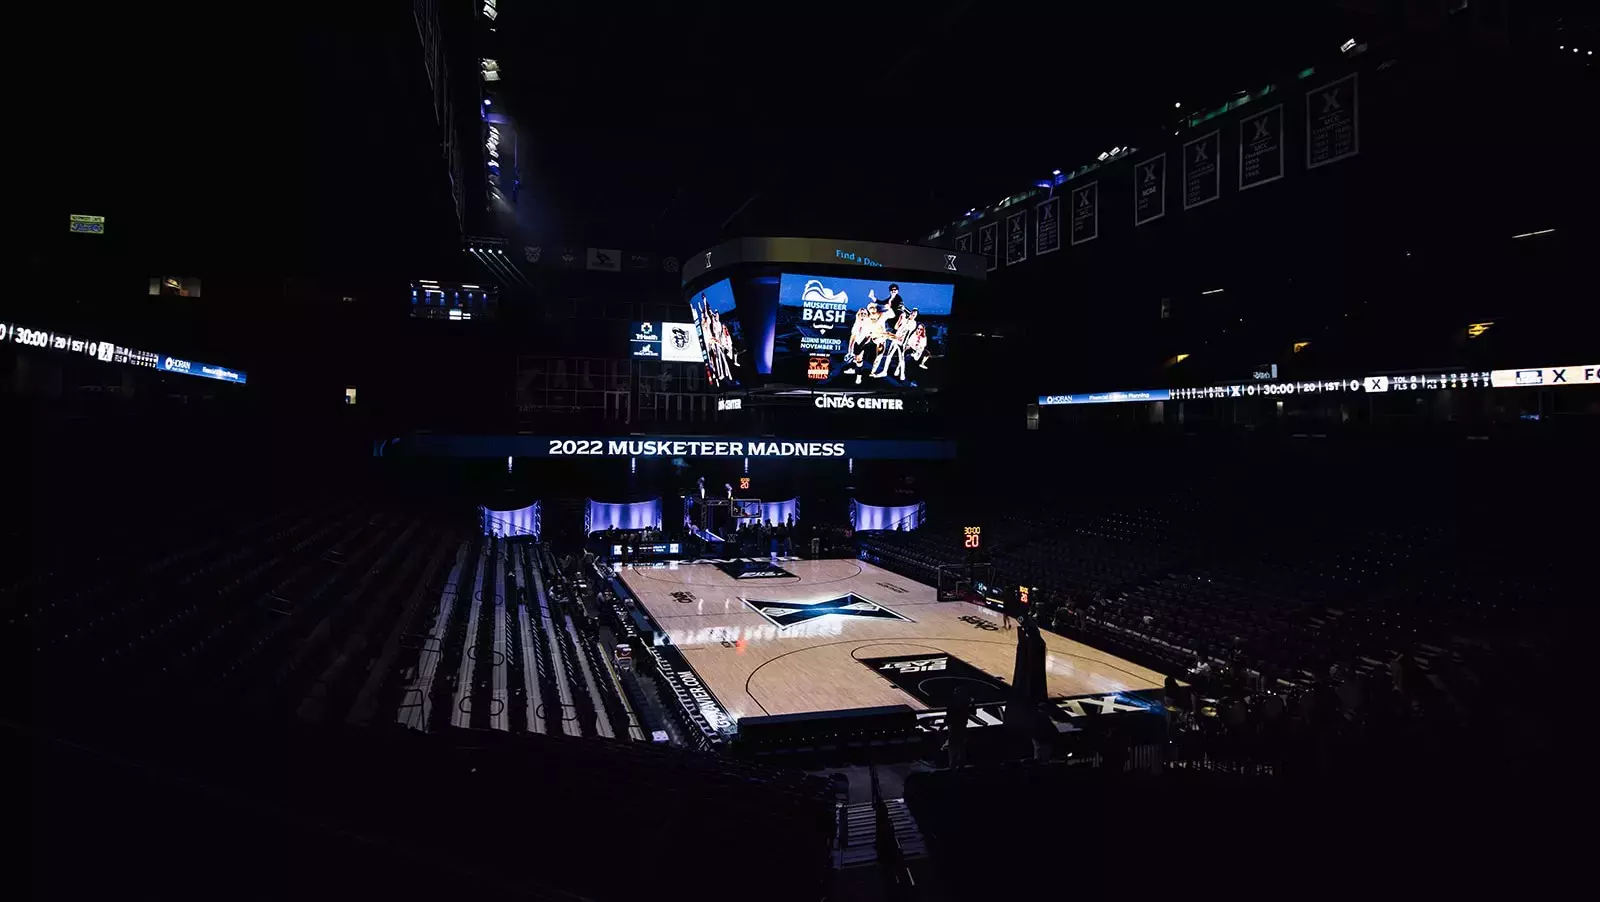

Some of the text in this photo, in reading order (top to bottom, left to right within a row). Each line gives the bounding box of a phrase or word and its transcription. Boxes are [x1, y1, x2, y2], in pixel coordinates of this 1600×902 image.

[836, 249, 855, 260] Find
[864, 257, 883, 267] Doc
[803, 301, 847, 311] MUSKETEER
[803, 309, 846, 323] BASH
[15, 327, 48, 348] 30:00
[800, 342, 833, 350] NOVEMBER
[1263, 383, 1295, 395] 30:00
[1303, 382, 1316, 392] 20
[1324, 381, 1340, 391] 1ST
[815, 393, 904, 410] CINTAS CENTER
[549, 440, 845, 456] 2022 MUSKETEER MADNESS
[964, 527, 981, 535] 30:00
[965, 535, 979, 547] 20
